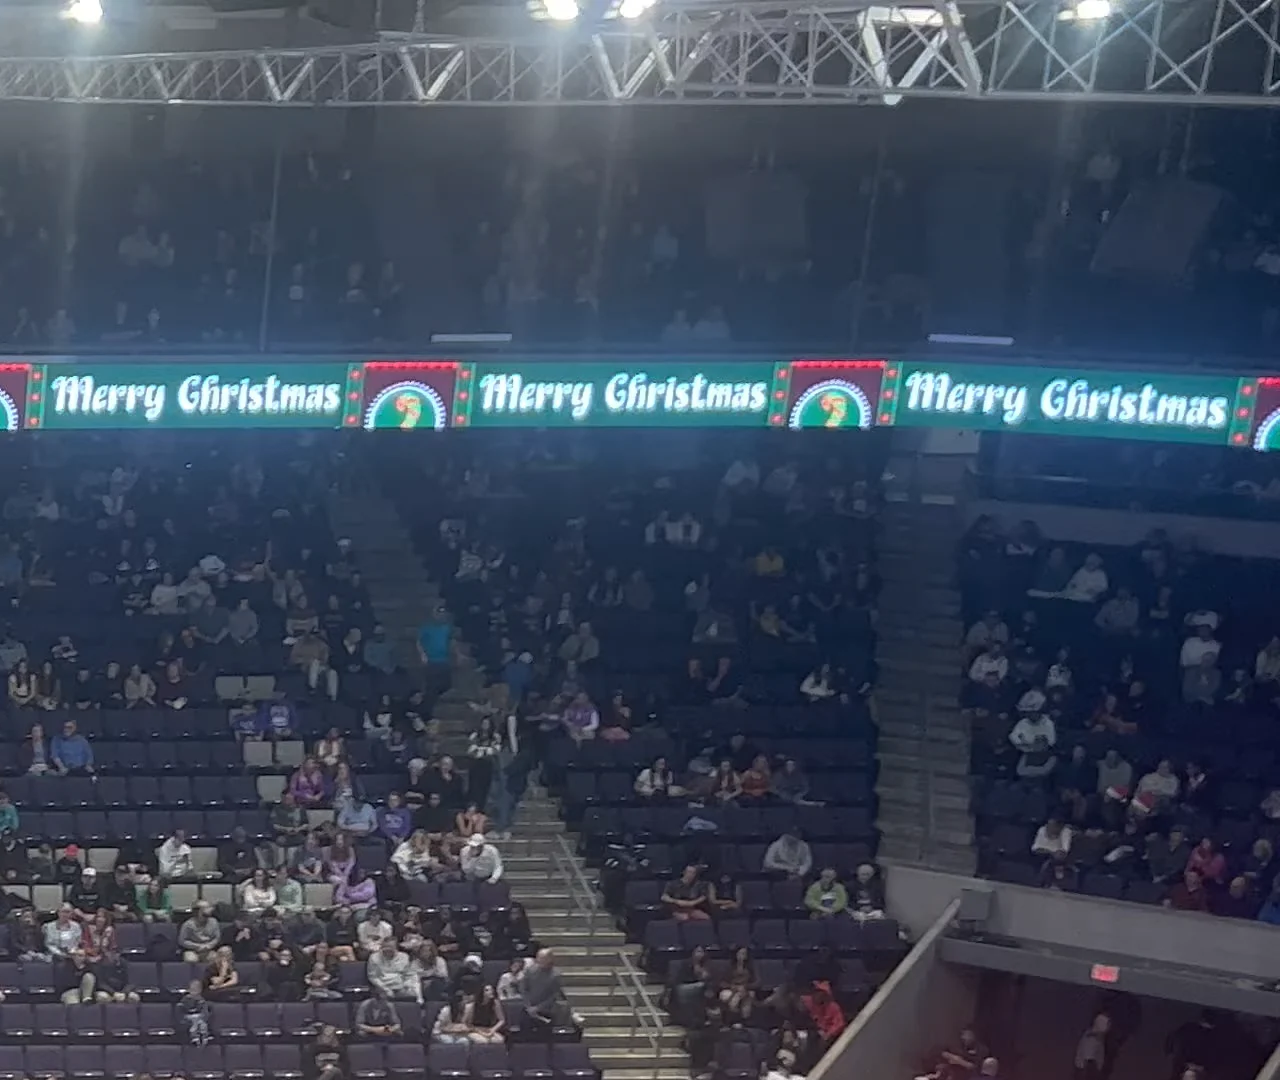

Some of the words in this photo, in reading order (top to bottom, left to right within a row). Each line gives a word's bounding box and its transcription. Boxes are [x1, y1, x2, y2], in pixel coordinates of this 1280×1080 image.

[51, 375, 165, 421] Merry
[176, 375, 340, 414] Christmas
[480, 374, 592, 417] Merry
[604, 375, 766, 411] Christmas
[905, 373, 1026, 422] Merry
[1040, 381, 1226, 427] Christmas
